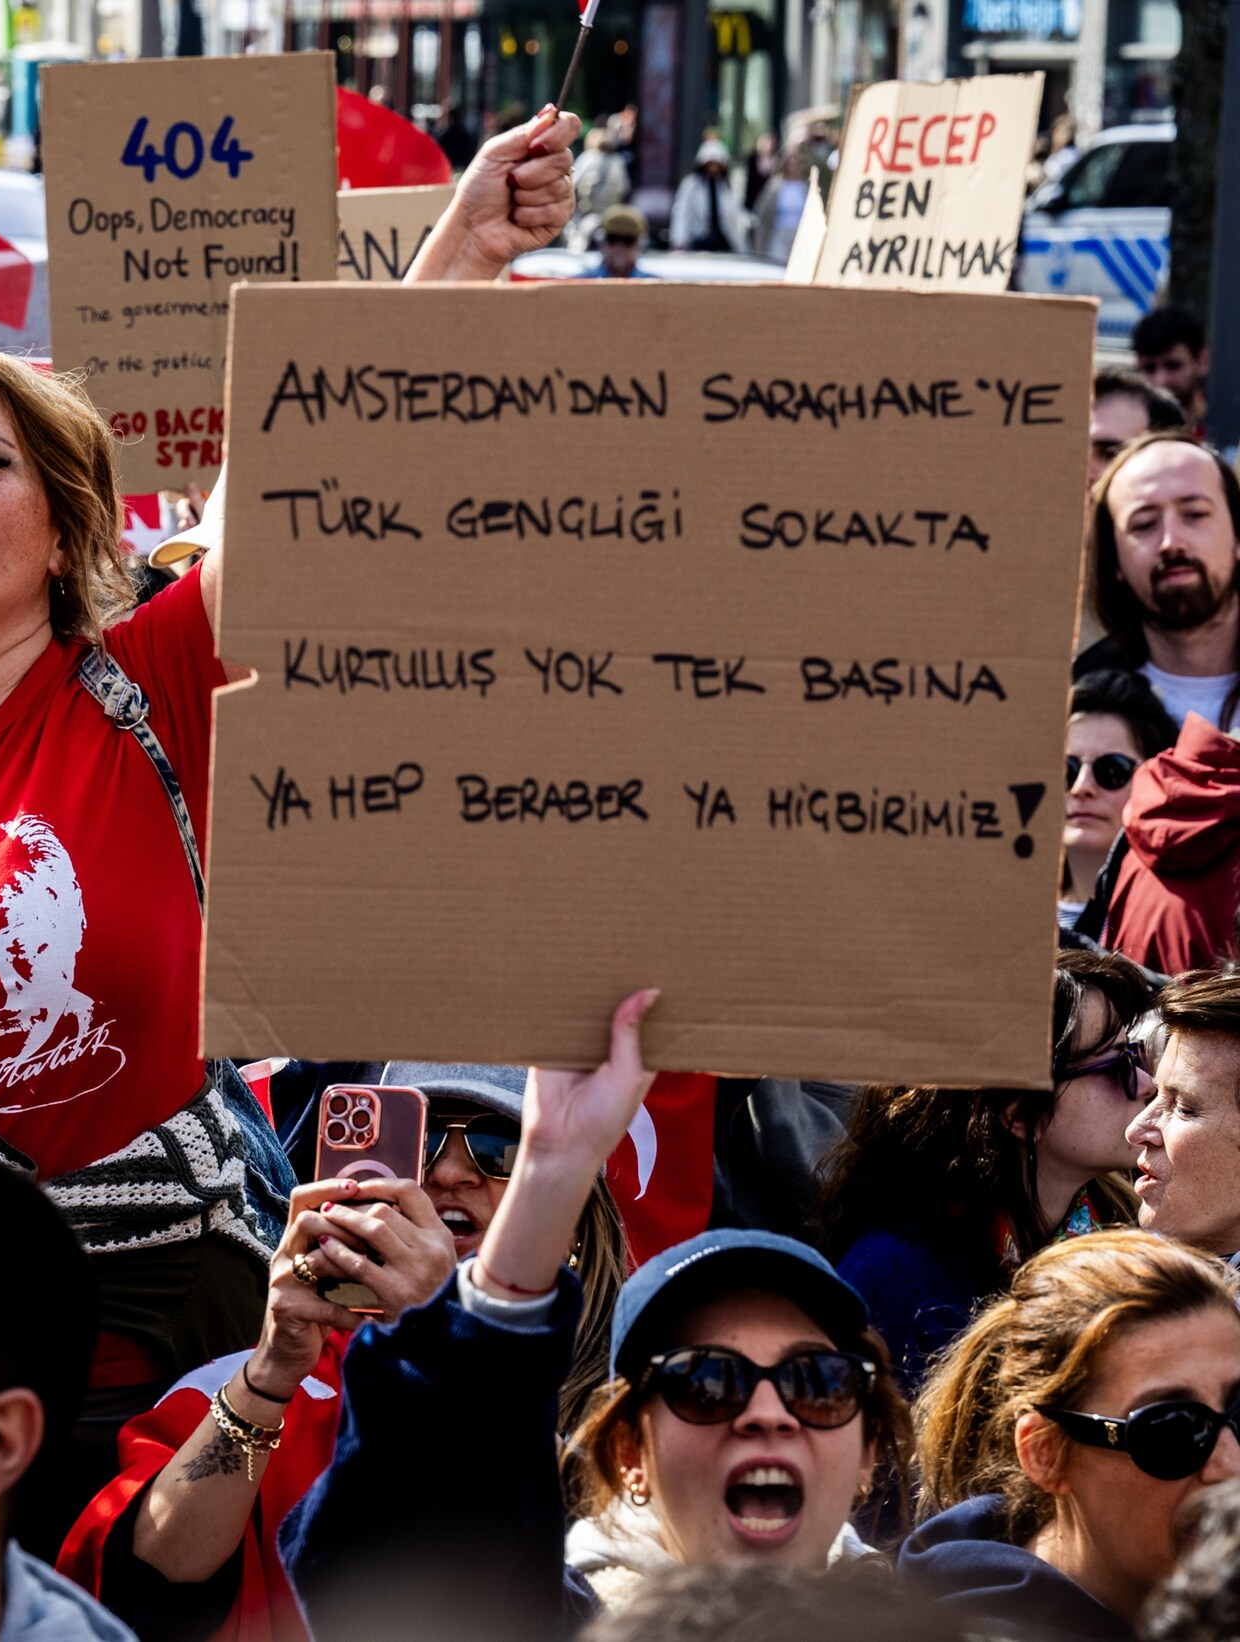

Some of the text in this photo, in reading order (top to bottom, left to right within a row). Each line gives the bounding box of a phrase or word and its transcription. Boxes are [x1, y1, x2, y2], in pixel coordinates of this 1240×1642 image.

[121, 115, 254, 182] 404
[864, 112, 997, 173] RECEP
[68, 198, 295, 241] Oops, Democracy
[854, 180, 932, 219] BEN
[124, 241, 299, 281] Not Found!
[840, 234, 1015, 279] AYRILMAK
[75, 305, 111, 323] The
[110, 407, 225, 437] GO BACK
[261, 478, 424, 541] TÜRK
[739, 503, 991, 552] SOKAKTA
[284, 637, 1007, 704] KURTULUŞ YOK TEK BAŞINA
[250, 766, 313, 831] YA
[328, 762, 424, 822] HEP
[456, 773, 650, 824] BERABER
[682, 780, 737, 829] YA
